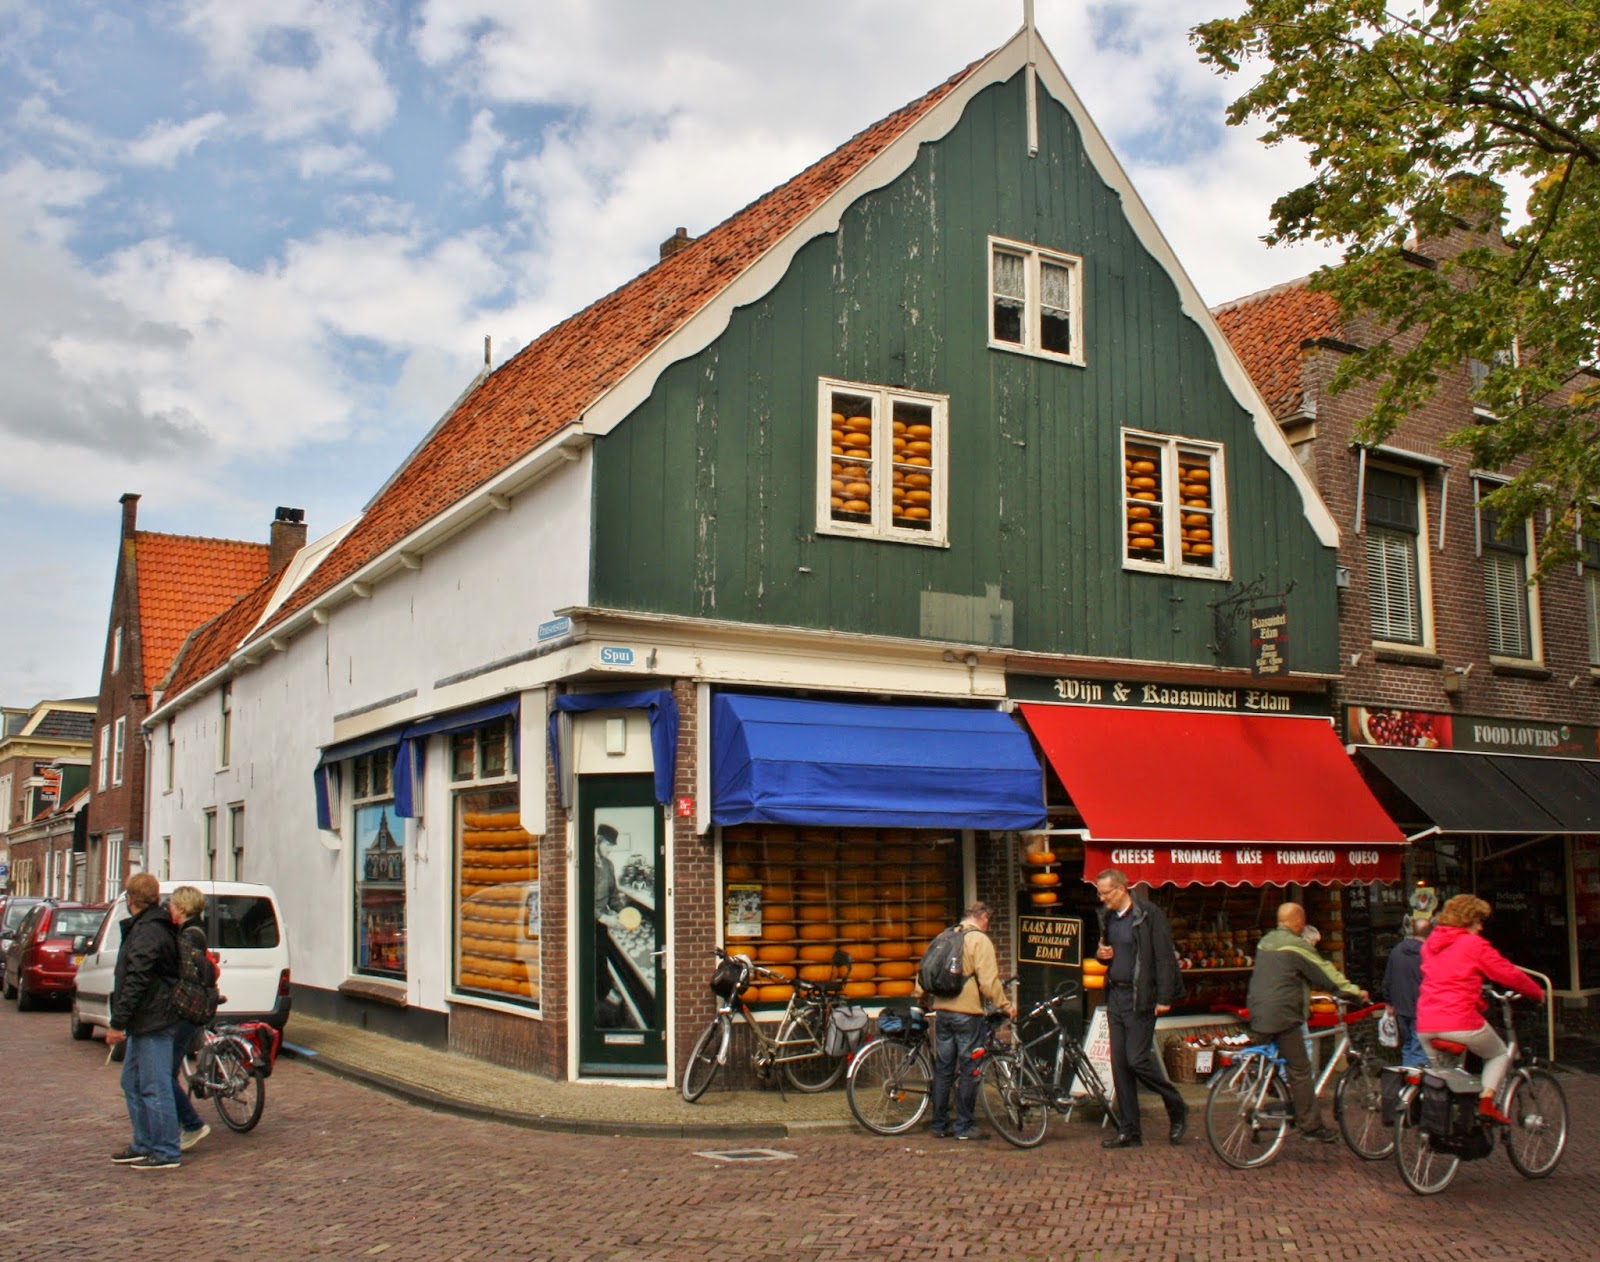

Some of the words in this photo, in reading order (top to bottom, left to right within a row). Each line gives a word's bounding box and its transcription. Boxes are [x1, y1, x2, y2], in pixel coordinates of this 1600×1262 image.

[604, 648, 630, 662] Spui
[1054, 678, 1102, 703] Wijn
[1113, 682, 1131, 702] &
[1142, 683, 1237, 709] Kaaswinkel
[1245, 690, 1290, 711] Edam
[1111, 849, 1155, 864] CHEESE
[1170, 849, 1222, 864] FROMAGE
[1236, 847, 1262, 864] KÄSE
[1277, 850, 1335, 865] FORMAGGIO
[1349, 850, 1379, 865] QUESO
[1022, 920, 1045, 933] KAAS
[1046, 922, 1053, 934] &
[1055, 922, 1078, 935] WIJN
[1028, 935, 1070, 946] SPECIAALZAAK
[1035, 945, 1064, 959] EDAM
